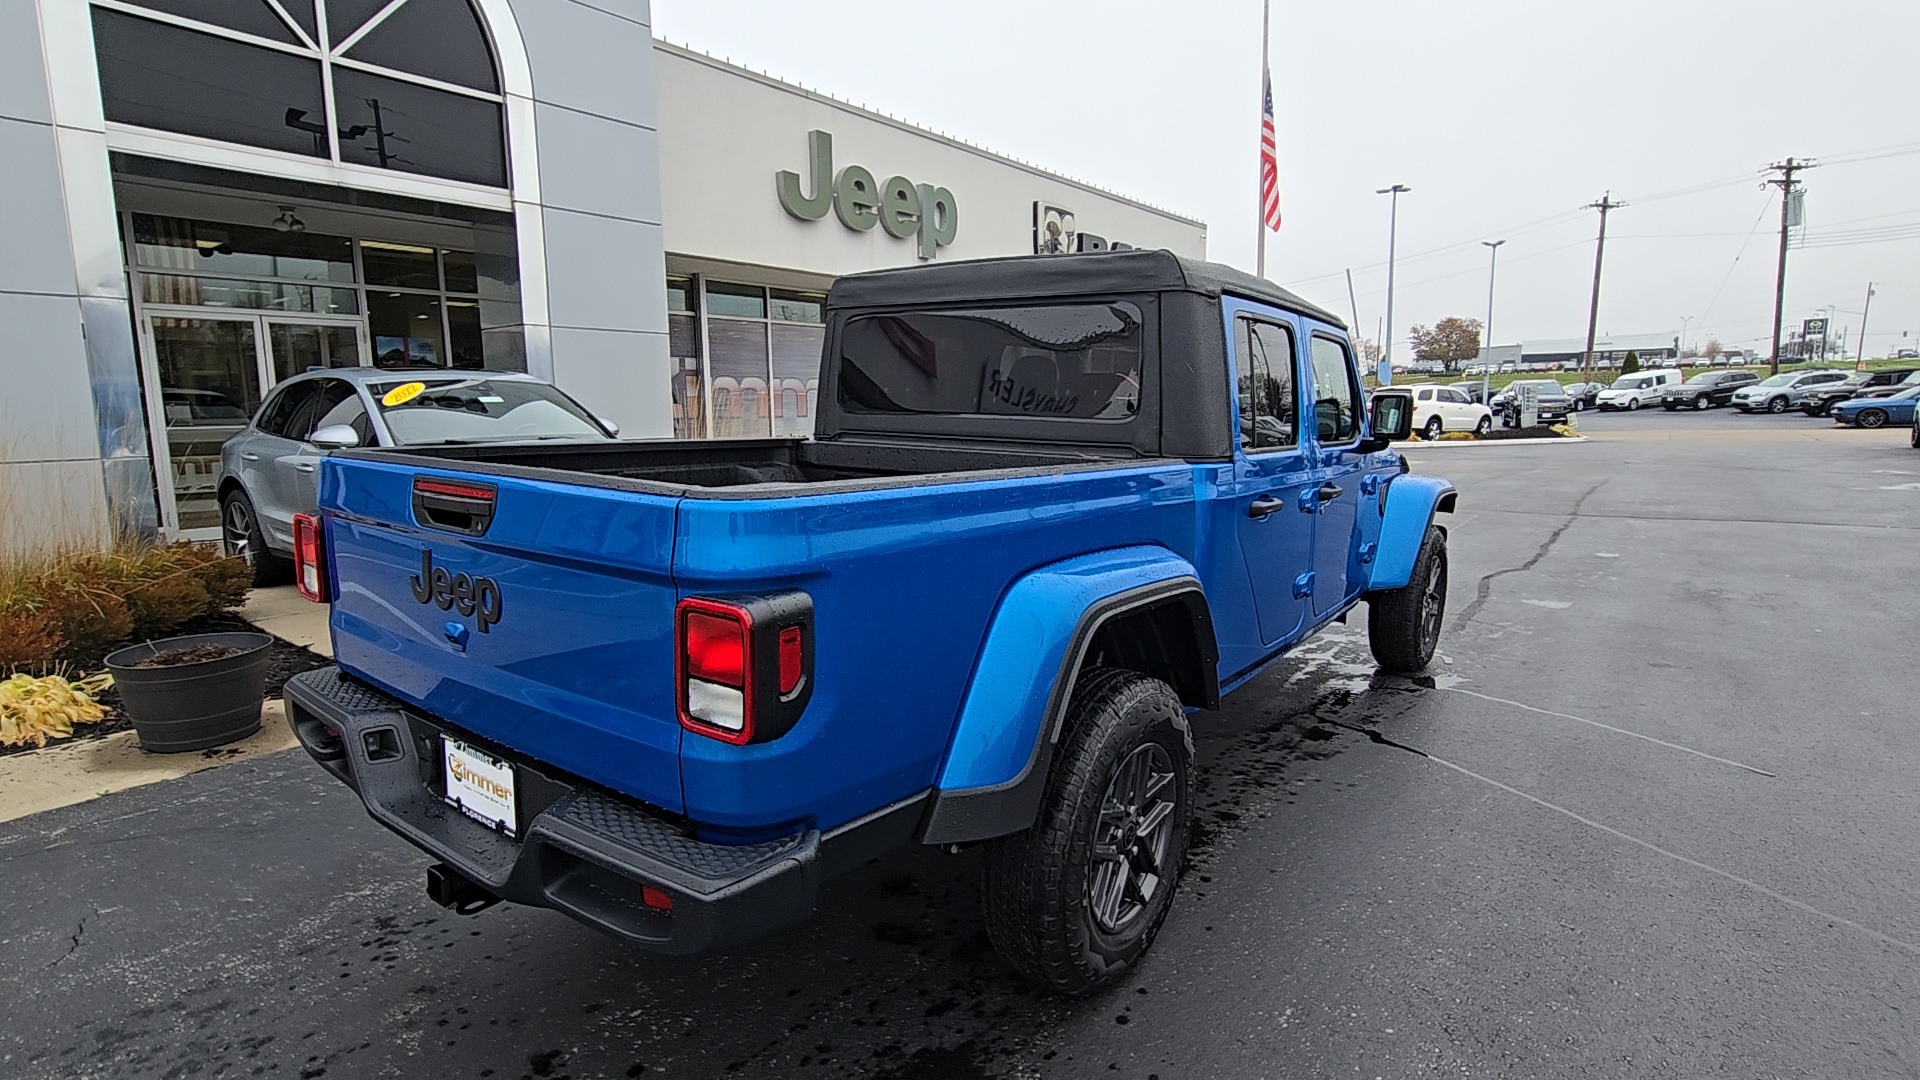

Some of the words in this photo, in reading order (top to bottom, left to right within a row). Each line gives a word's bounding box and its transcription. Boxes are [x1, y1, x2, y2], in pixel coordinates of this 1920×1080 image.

[776, 129, 958, 260] Jeep
[391, 384, 419, 402] 2022
[409, 548, 503, 634] Jeep
[448, 753, 513, 801] Zimmer
